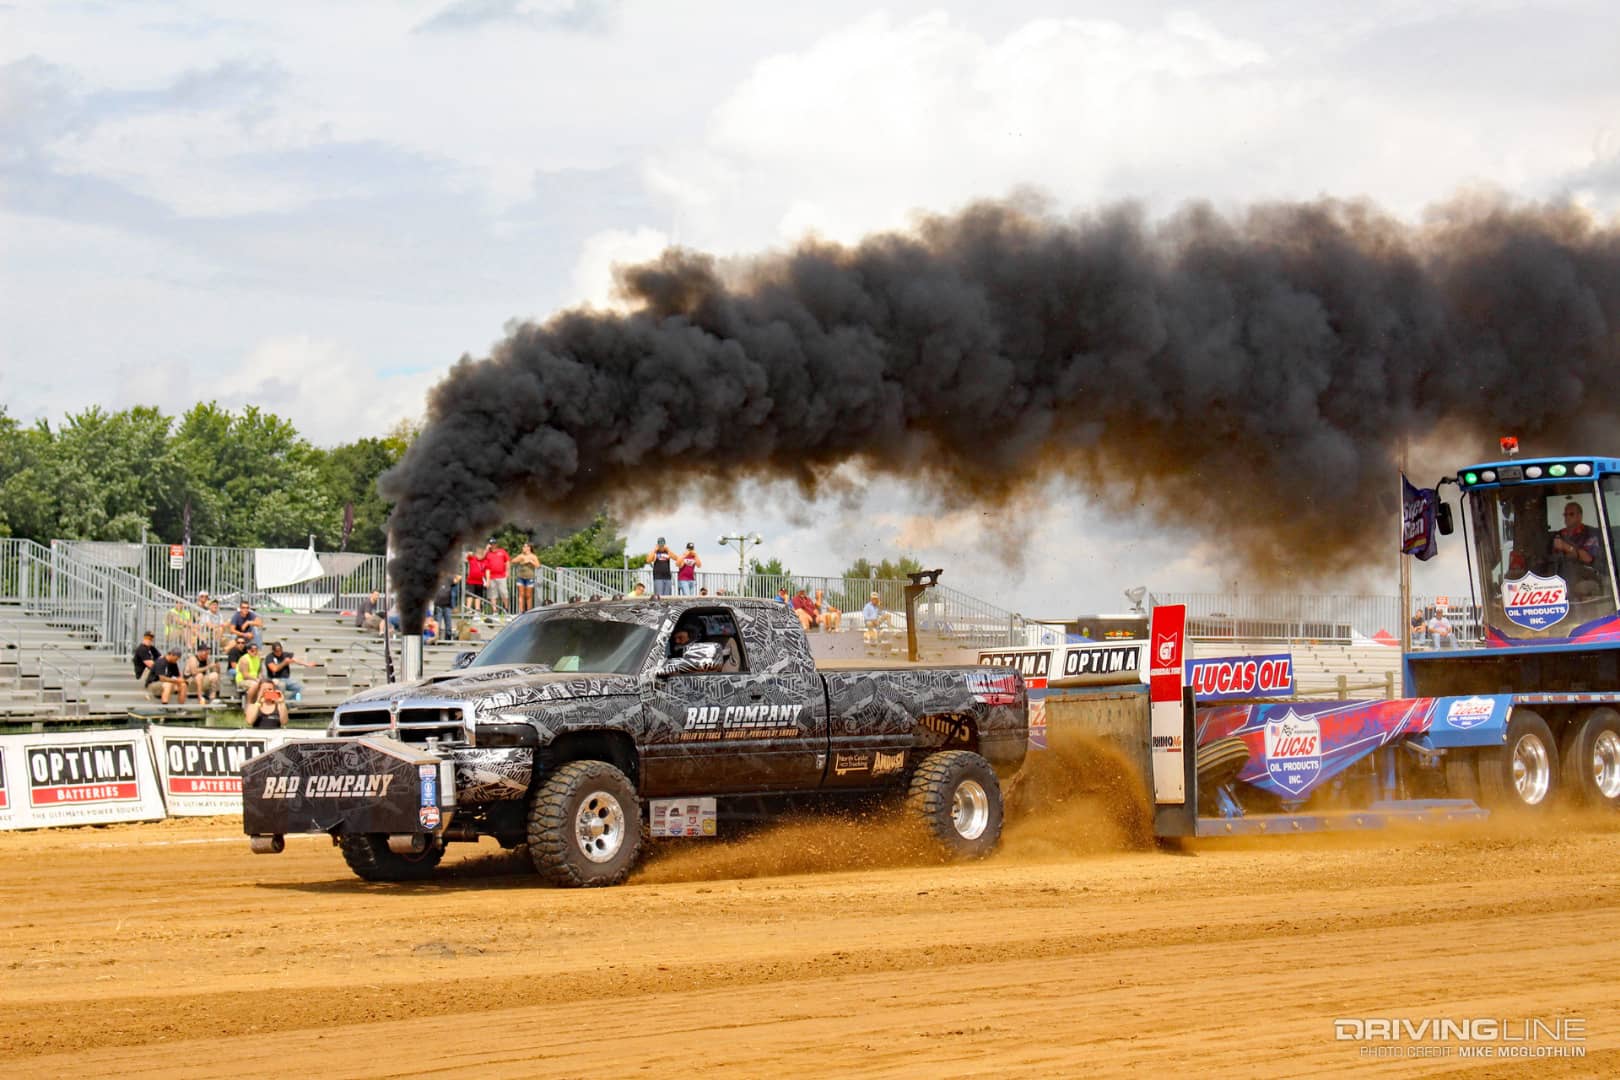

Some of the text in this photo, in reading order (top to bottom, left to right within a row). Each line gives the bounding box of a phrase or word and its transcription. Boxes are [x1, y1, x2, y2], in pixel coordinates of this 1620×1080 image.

[1510, 589, 1562, 606] LUCAS
[1523, 606, 1566, 616] PRODUCTS
[1067, 650, 1136, 674] OPTIMA
[1192, 660, 1291, 694] LUCAS OIL
[684, 704, 802, 730] BAD COMPANY
[1272, 736, 1317, 758] LUCAS
[31, 749, 130, 782] OPTIMA
[1270, 760, 1319, 772] OIL PRODUCTS
[191, 780, 242, 791] BATTERIE
[262, 774, 393, 799] BAD COMPANY
[1288, 775, 1303, 785] INC.
[57, 786, 119, 800] BATTERIES
